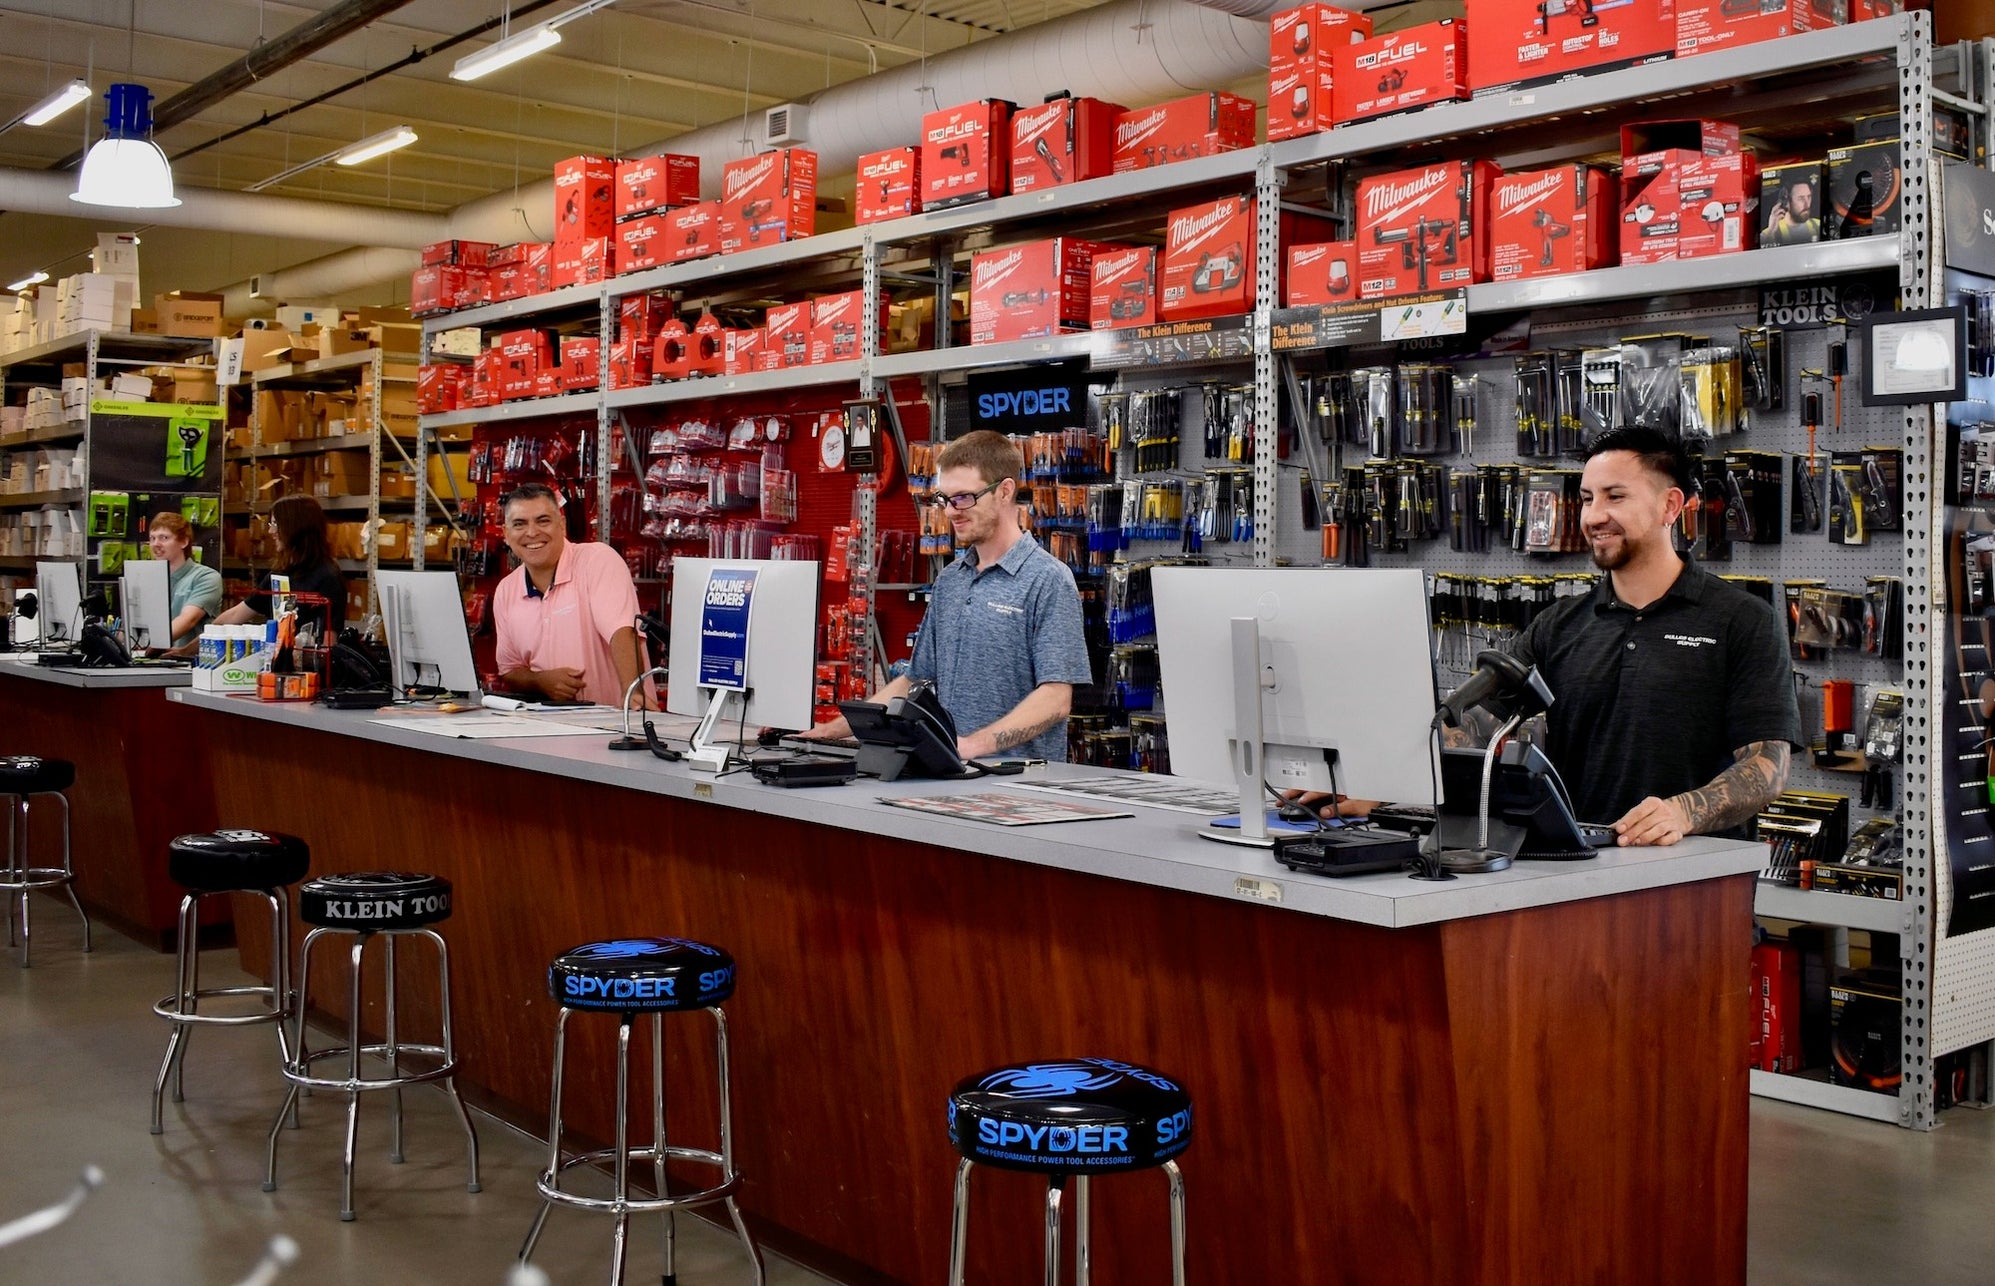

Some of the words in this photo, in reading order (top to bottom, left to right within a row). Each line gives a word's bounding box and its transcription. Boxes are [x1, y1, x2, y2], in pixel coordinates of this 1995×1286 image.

[1357, 55, 1375, 67] M18
[1377, 41, 1428, 64] FUEL
[945, 120, 983, 137] FUEL
[1016, 105, 1062, 139] Milwaukee
[1118, 109, 1167, 146] Milwaukee
[634, 167, 658, 181] FUEL
[726, 156, 775, 194] Milwaukee
[876, 159, 908, 173] FUEL
[1364, 167, 1448, 218] Milwaukee
[1497, 172, 1563, 211] Milwaukee
[687, 212, 710, 226] FUEL
[1169, 202, 1234, 248] Milwaukee
[634, 226, 658, 239] FUEL
[1094, 250, 1139, 281] Milwaukee
[1293, 246, 1327, 266] Milwaukee
[974, 248, 1023, 285] Milwaukee
[1363, 281, 1382, 291] M12
[1374, 299, 1385, 308] and
[1763, 286, 1838, 309] KLEIN
[768, 302, 799, 331] Milwaukee
[817, 295, 851, 321] Milwaukee
[1762, 304, 1838, 326] TOOLS
[350, 331, 369, 341] 3M
[1138, 326, 1151, 339] The
[1152, 324, 1172, 337] Klein
[1173, 322, 1212, 335] Difference
[1272, 324, 1289, 338] The
[1290, 322, 1314, 335] Klein
[1272, 335, 1318, 350] Difference
[1401, 336, 1444, 350] TOOLS
[978, 386, 1071, 419] SPYDER
[709, 579, 745, 593] ONLINE
[707, 592, 745, 606] ORDERS
[325, 900, 404, 919] KLEIN
[565, 975, 675, 998] SPYDER
[606, 1000, 627, 1008] POWER
[642, 998, 679, 1007] ACCESSORIES
[1762, 996, 1770, 1044] FUEL
[978, 1117, 1131, 1152] SPYDER
[989, 1149, 1037, 1163] PERFORMANCE
[1038, 1154, 1065, 1165] POWER
[1066, 1156, 1085, 1165] TOOL
[1086, 1155, 1135, 1165] ACCESSORIES
